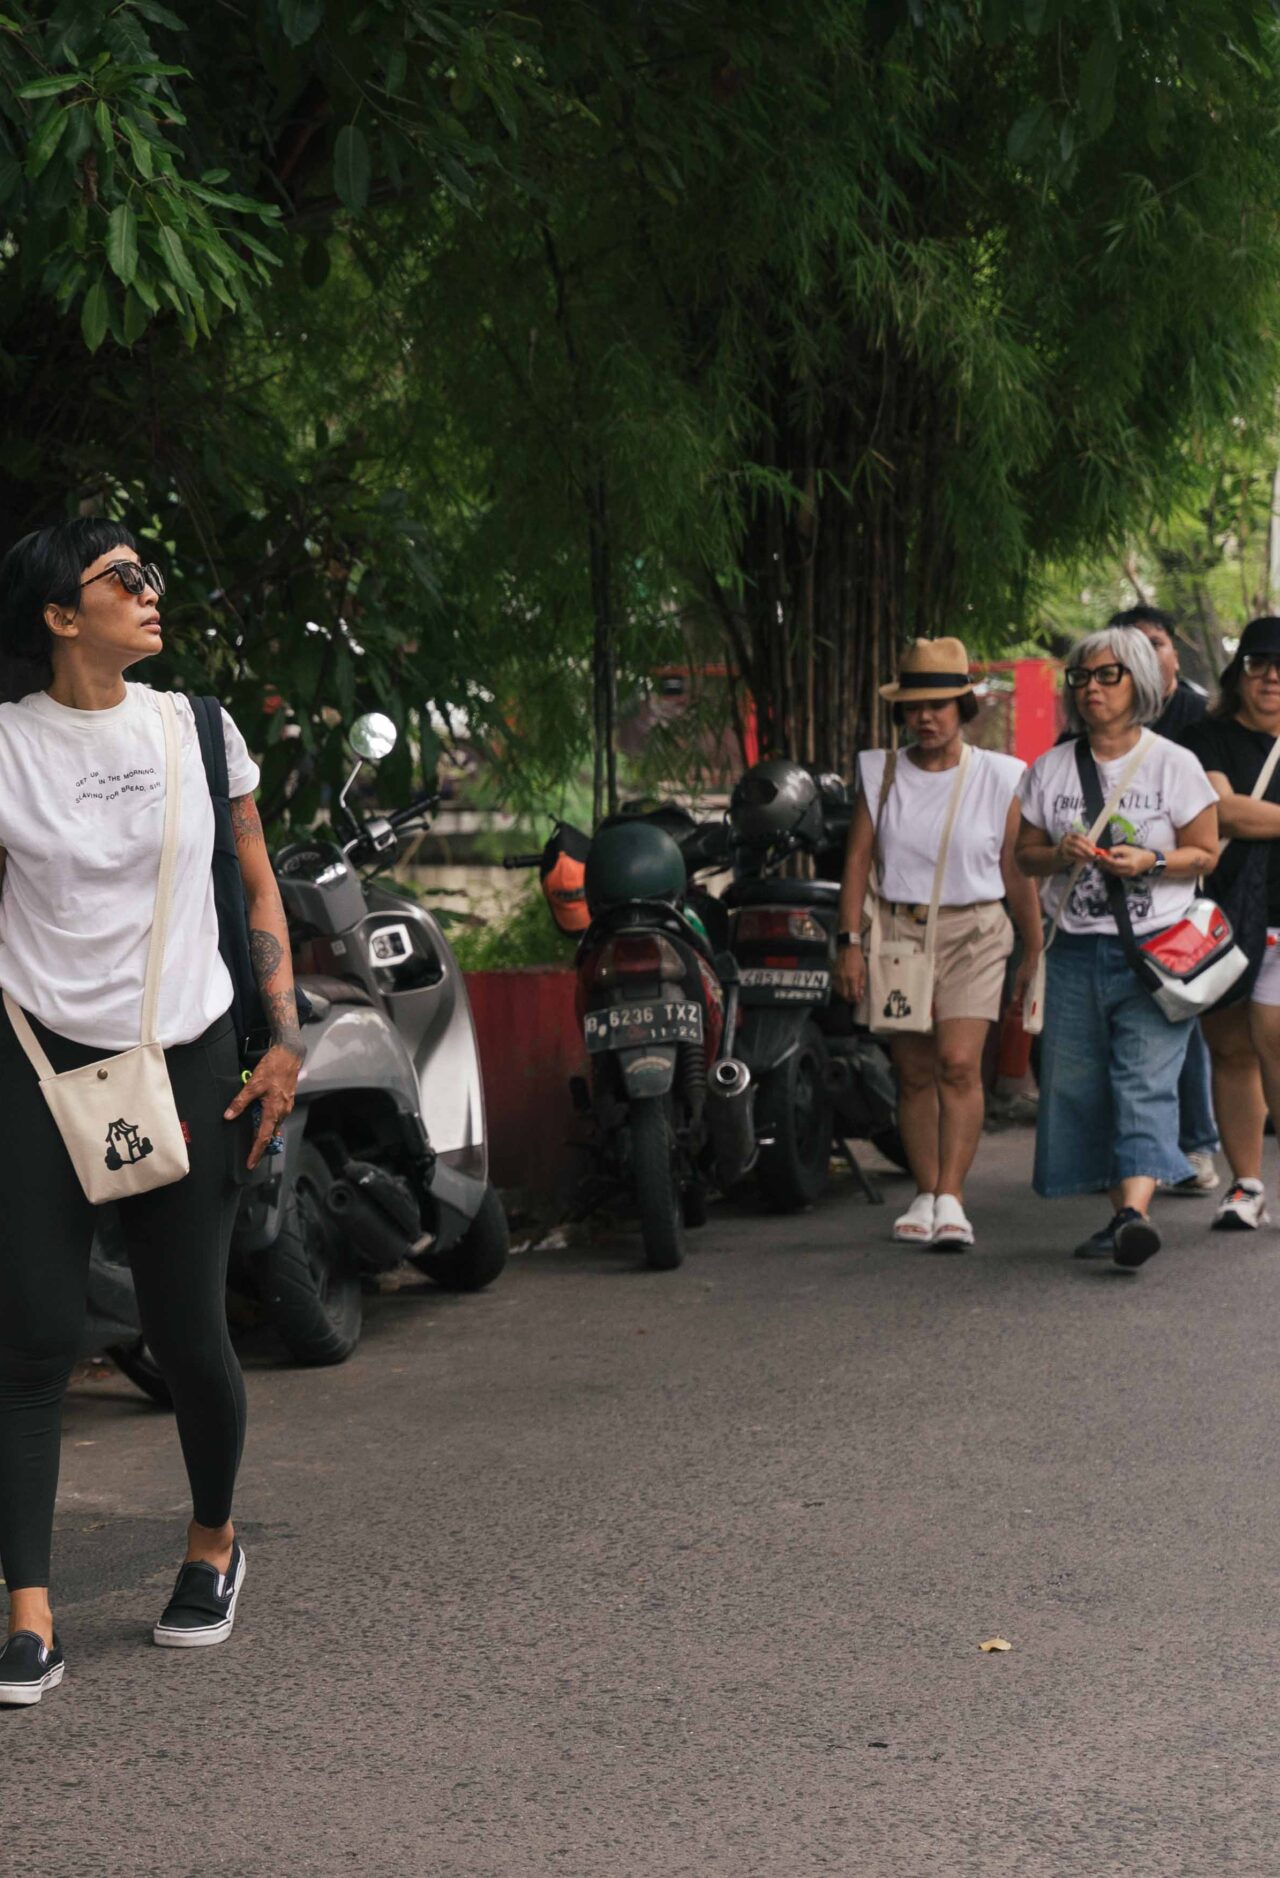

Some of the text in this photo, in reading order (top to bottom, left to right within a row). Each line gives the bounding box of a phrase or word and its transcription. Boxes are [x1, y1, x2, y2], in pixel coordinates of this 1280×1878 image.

[75, 777, 88, 788] GET
[75, 792, 103, 803] SLAVING
[106, 791, 119, 801] FOR
[609, 1006, 654, 1028] 6236
[665, 1003, 699, 1023] TXZ
